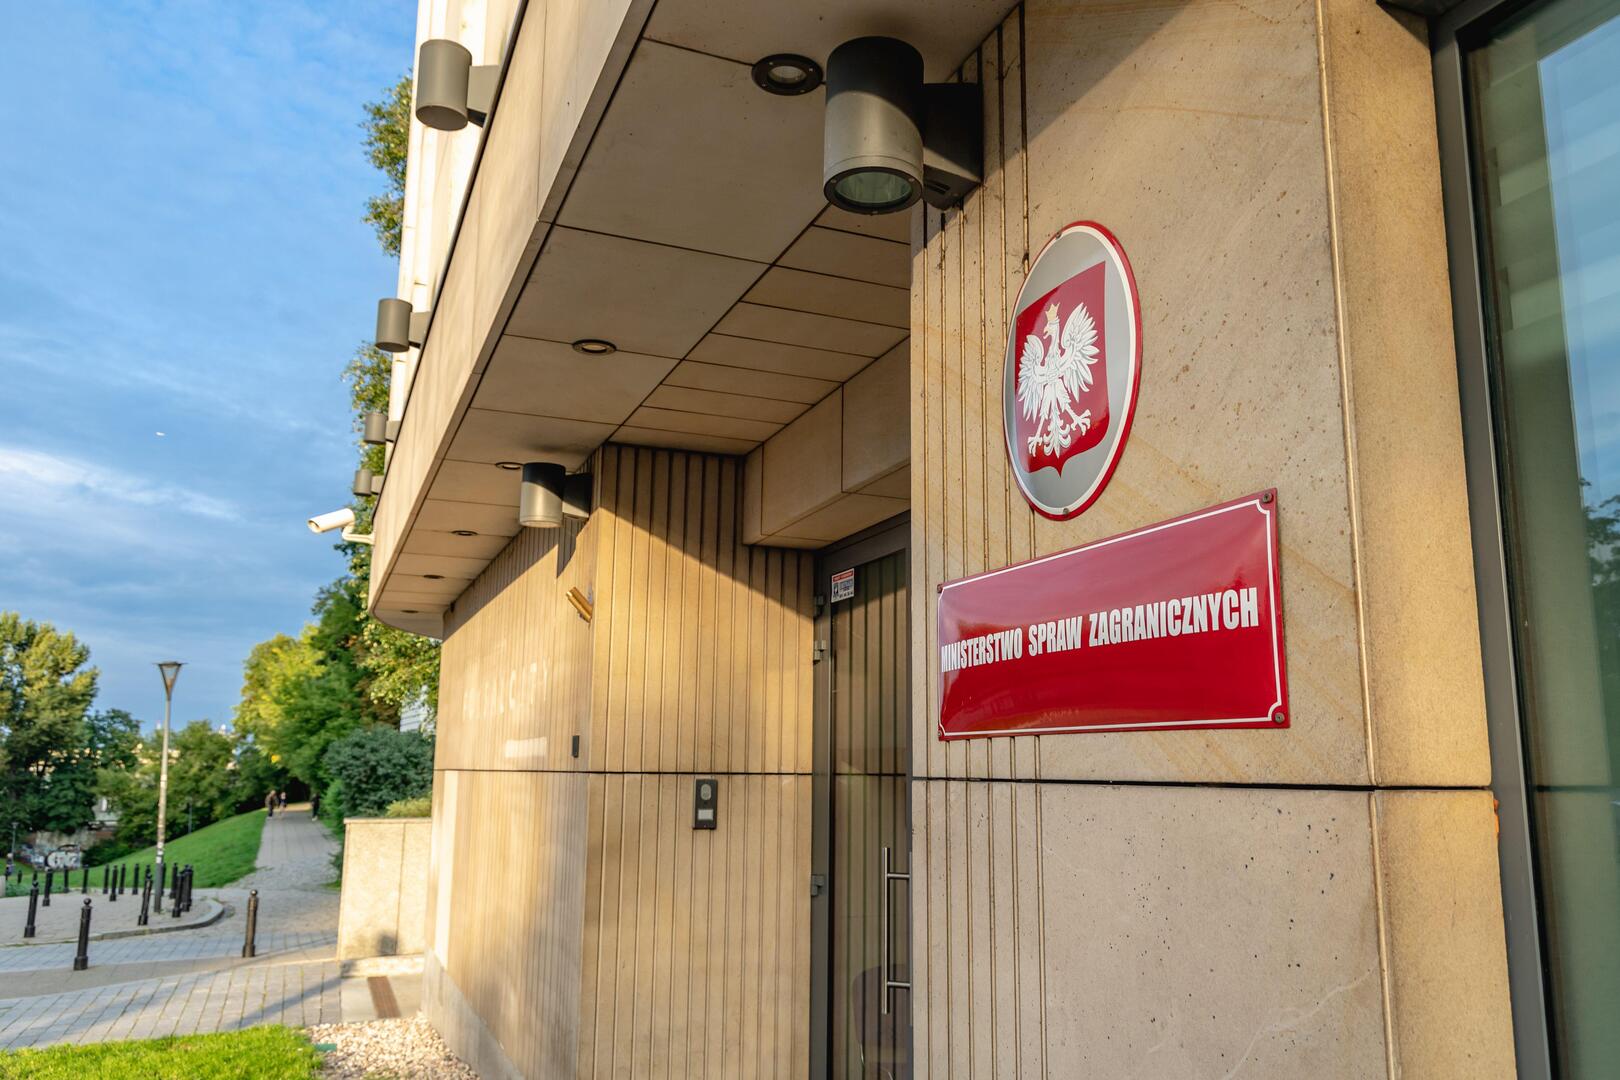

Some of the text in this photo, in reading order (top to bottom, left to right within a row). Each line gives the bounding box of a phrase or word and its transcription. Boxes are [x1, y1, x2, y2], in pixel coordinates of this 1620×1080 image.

[941, 587, 1259, 673] MINISTERSTWO SPRAW ZAGRANICZNYCH
